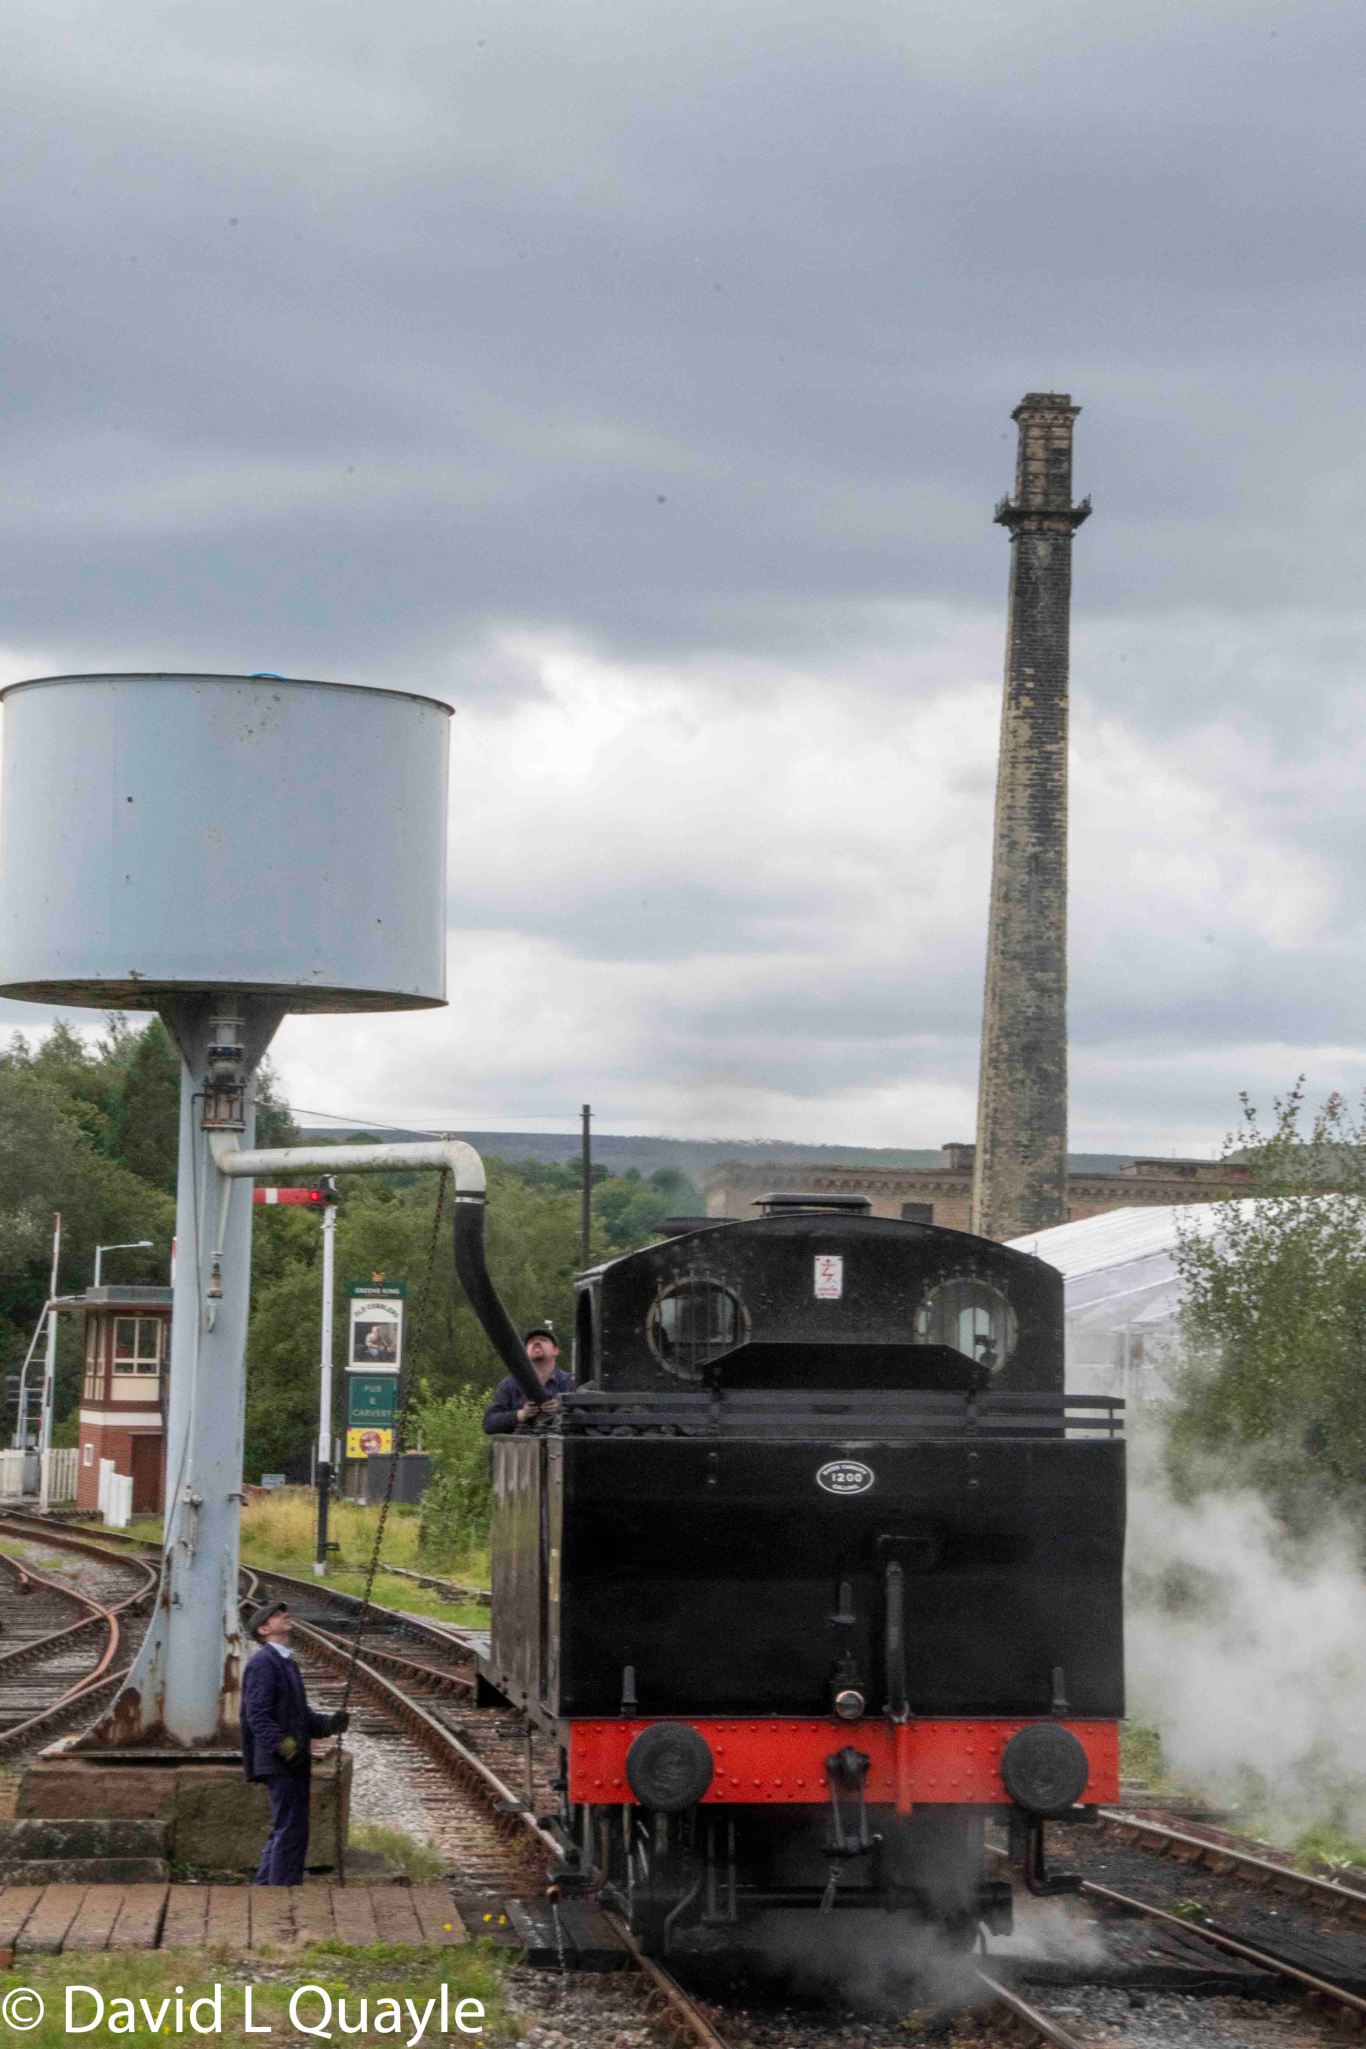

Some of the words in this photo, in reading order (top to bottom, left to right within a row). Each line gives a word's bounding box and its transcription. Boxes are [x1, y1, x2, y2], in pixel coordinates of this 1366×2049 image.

[364, 1384, 382, 1393] PUB
[352, 1408, 392, 1417] CARVERY
[831, 1472, 863, 1483] 1200
